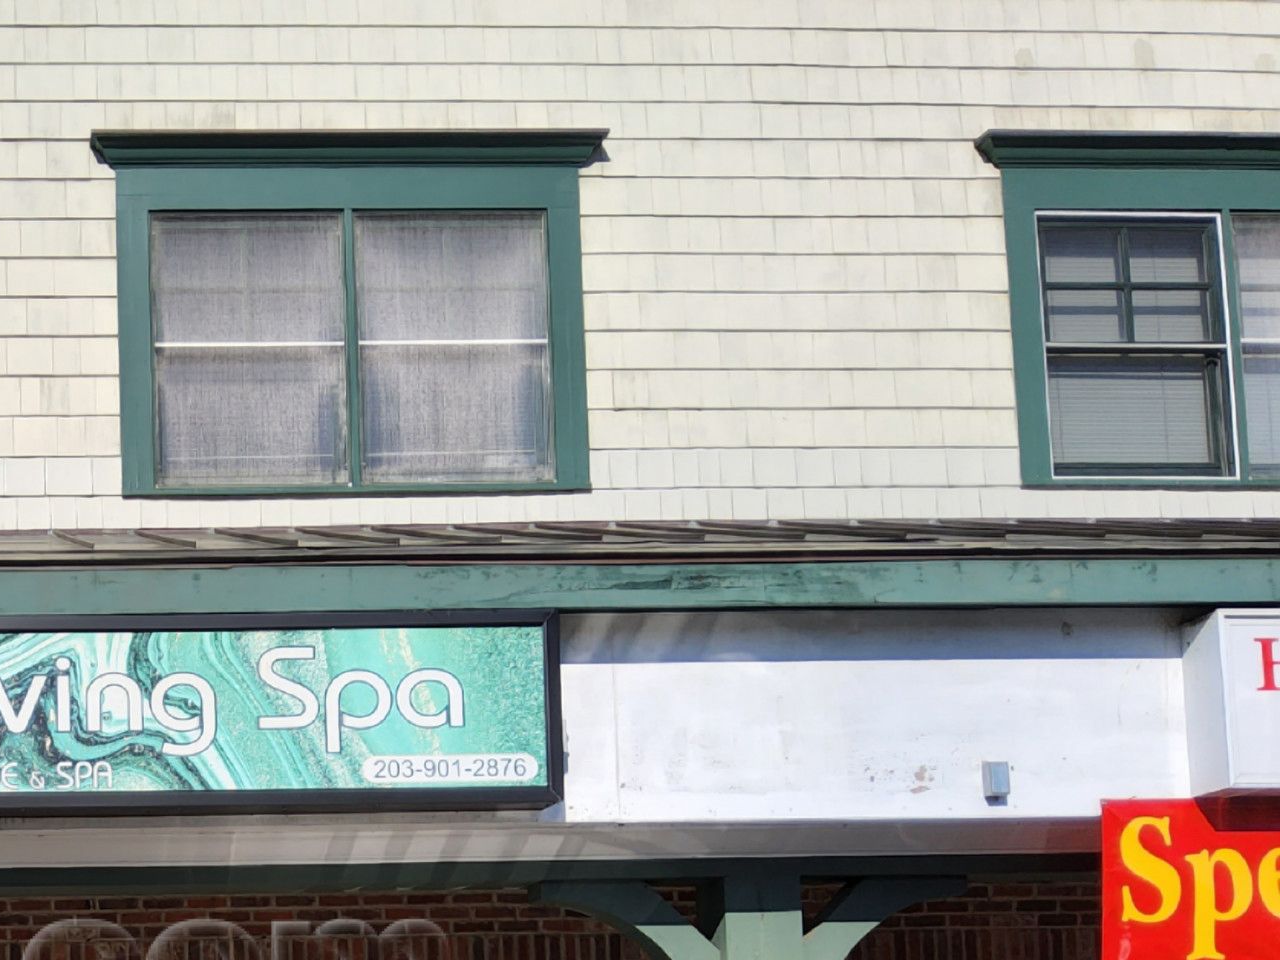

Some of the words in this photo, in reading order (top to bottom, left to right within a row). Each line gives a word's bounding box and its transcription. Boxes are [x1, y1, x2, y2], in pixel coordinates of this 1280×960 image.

[256, 646, 464, 754] Spa
[28, 770, 45, 789] &
[56, 761, 113, 788] SPA
[373, 757, 527, 778] 203-901-2876
